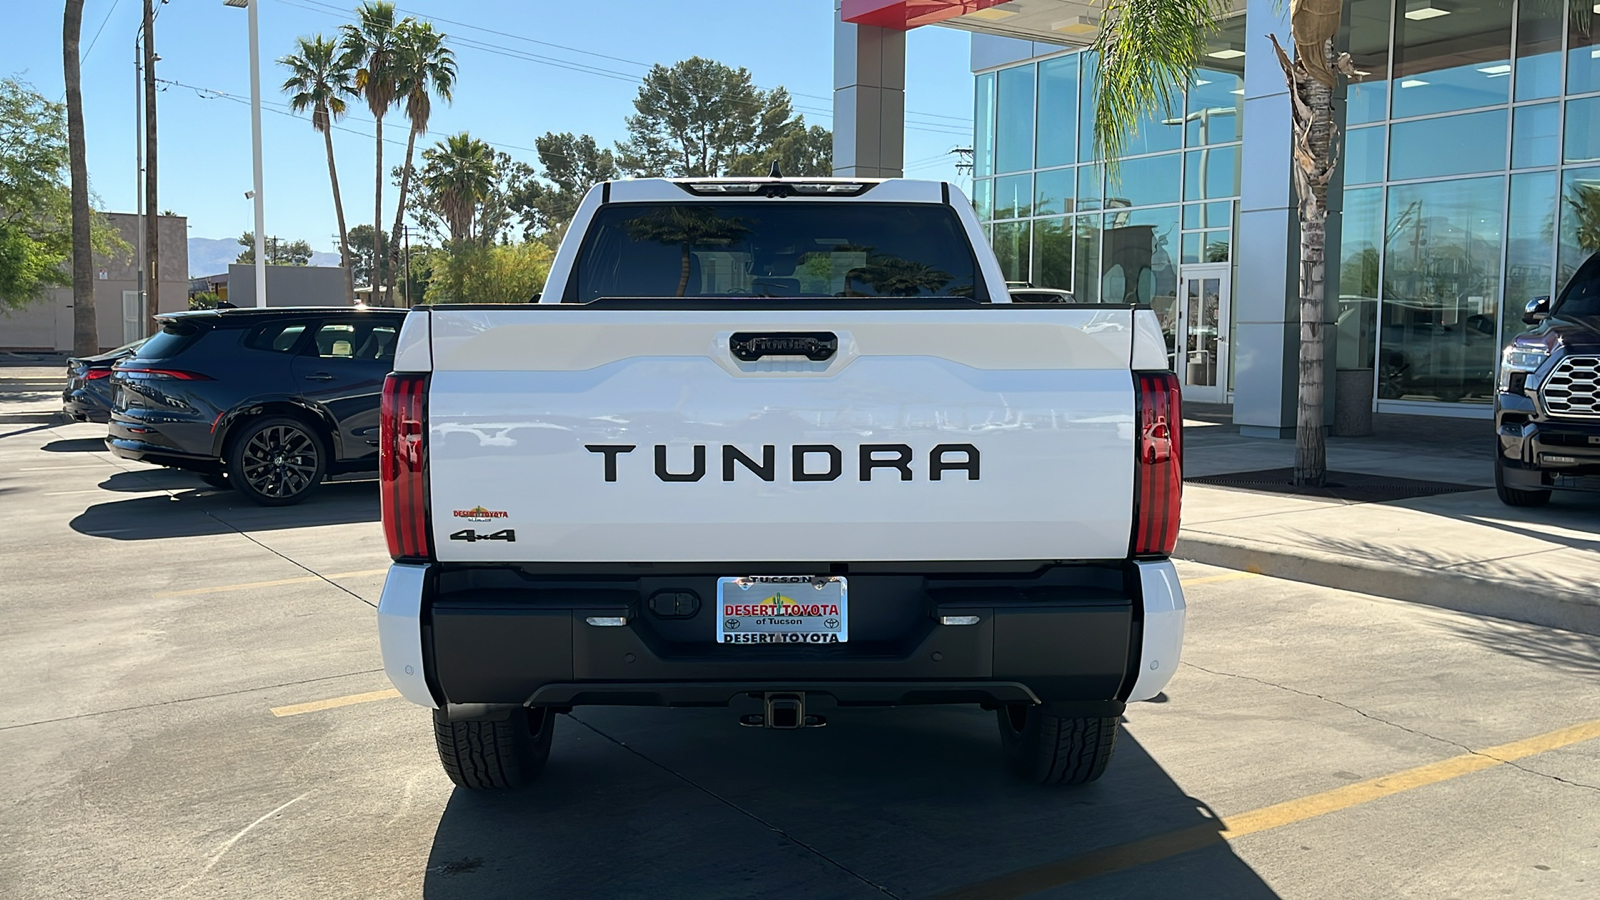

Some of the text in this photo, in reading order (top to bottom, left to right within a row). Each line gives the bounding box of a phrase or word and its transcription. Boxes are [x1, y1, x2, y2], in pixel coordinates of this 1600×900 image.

[584, 444, 981, 482] TUNDRA
[450, 529, 516, 542] 4x4
[725, 604, 839, 616] DESERT TOYOTA
[724, 633, 840, 643] DESERT TOYOTA
